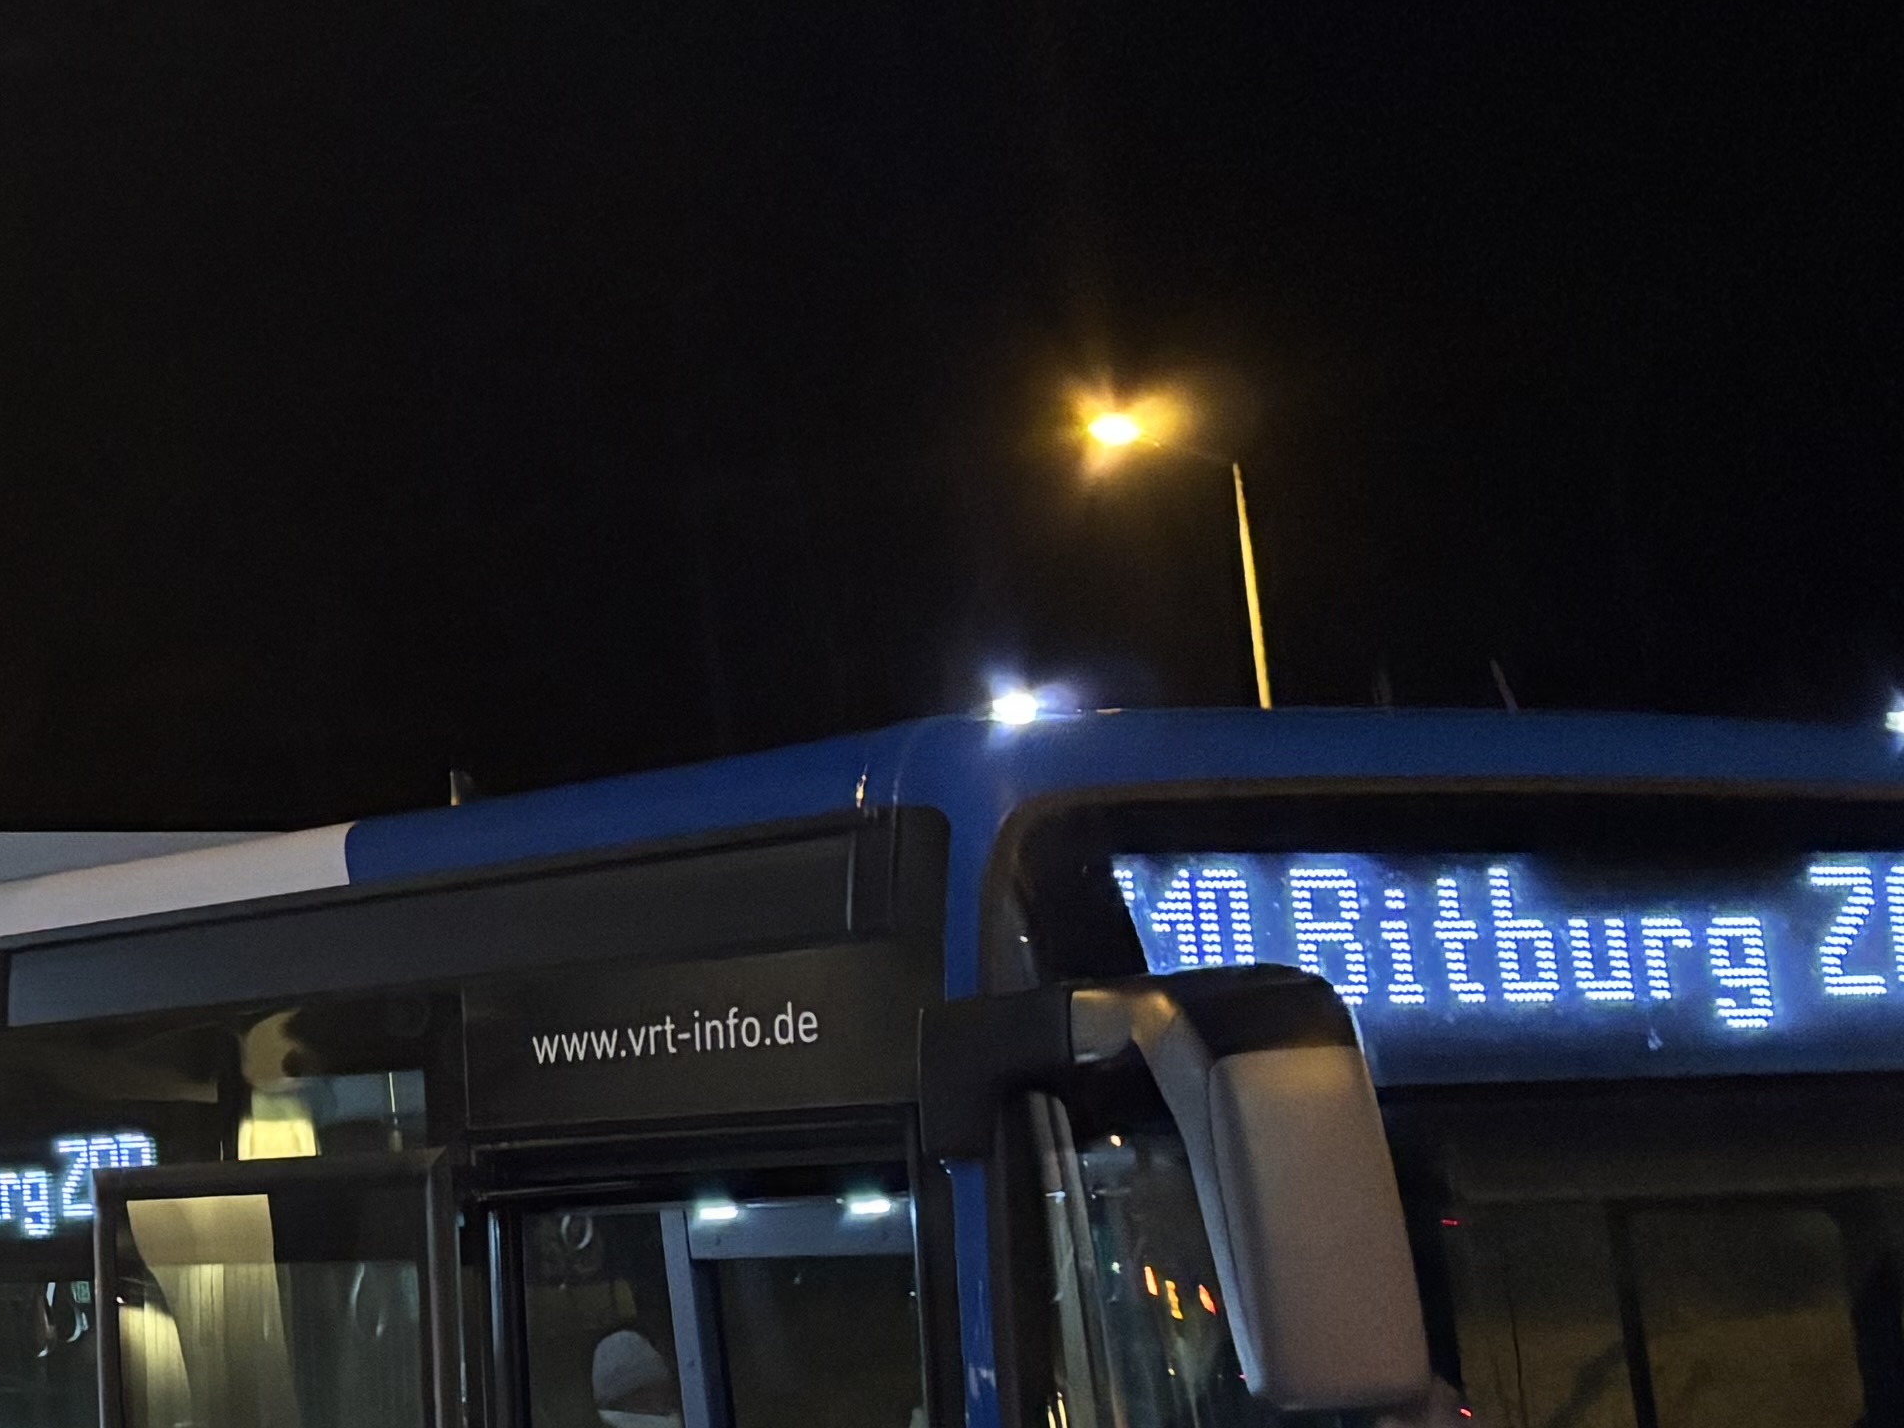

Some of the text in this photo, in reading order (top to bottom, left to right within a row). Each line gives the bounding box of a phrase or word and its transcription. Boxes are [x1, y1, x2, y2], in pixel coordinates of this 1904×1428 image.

[1289, 866, 1775, 1030] Bitburg
[1809, 865, 1904, 997] Z
[532, 1000, 820, 1065] www.vrt-info.de
